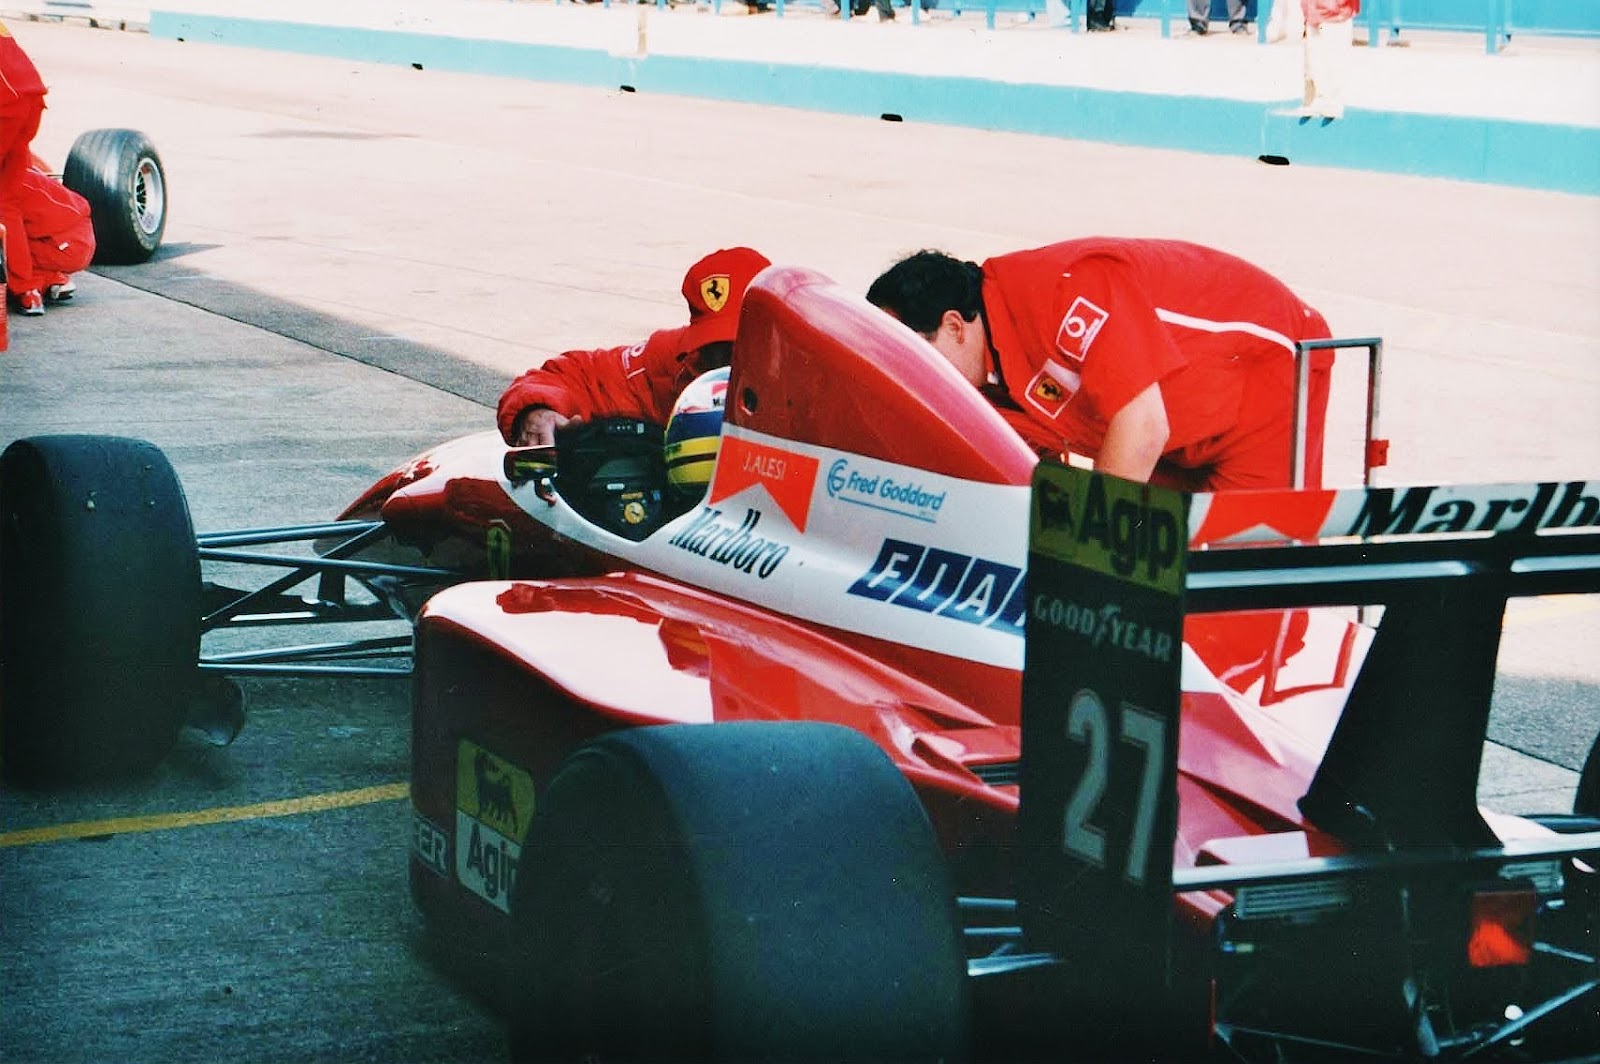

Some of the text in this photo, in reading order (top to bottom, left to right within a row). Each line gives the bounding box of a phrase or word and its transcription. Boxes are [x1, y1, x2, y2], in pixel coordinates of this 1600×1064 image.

[743, 451, 787, 480] J.ALESI
[847, 471, 946, 511] Fred Goddard
[668, 506, 789, 579] Marlboro
[1077, 472, 1179, 580] Agip
[1064, 688, 1167, 886] 27
